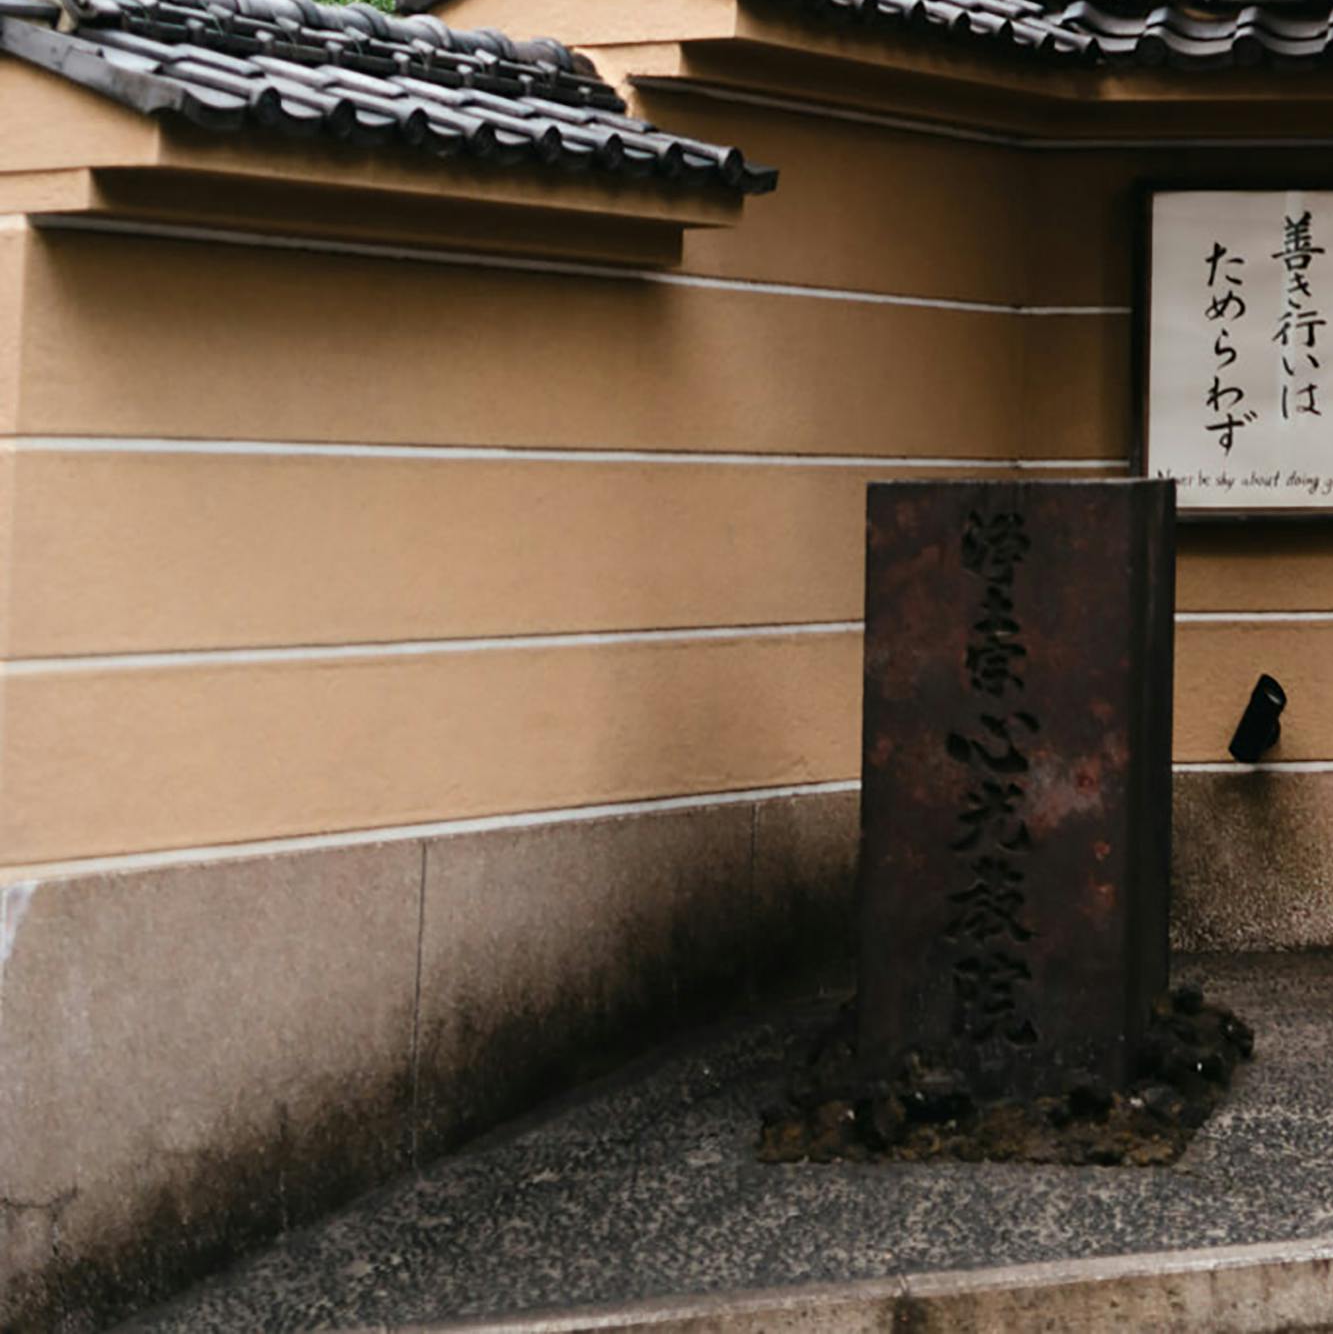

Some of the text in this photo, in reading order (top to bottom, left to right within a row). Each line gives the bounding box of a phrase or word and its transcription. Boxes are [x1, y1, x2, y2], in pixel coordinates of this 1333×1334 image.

[1204, 241, 1258, 456] ためらわず
[1271, 211, 1326, 420] 善き行いは
[1240, 470, 1280, 487] about
